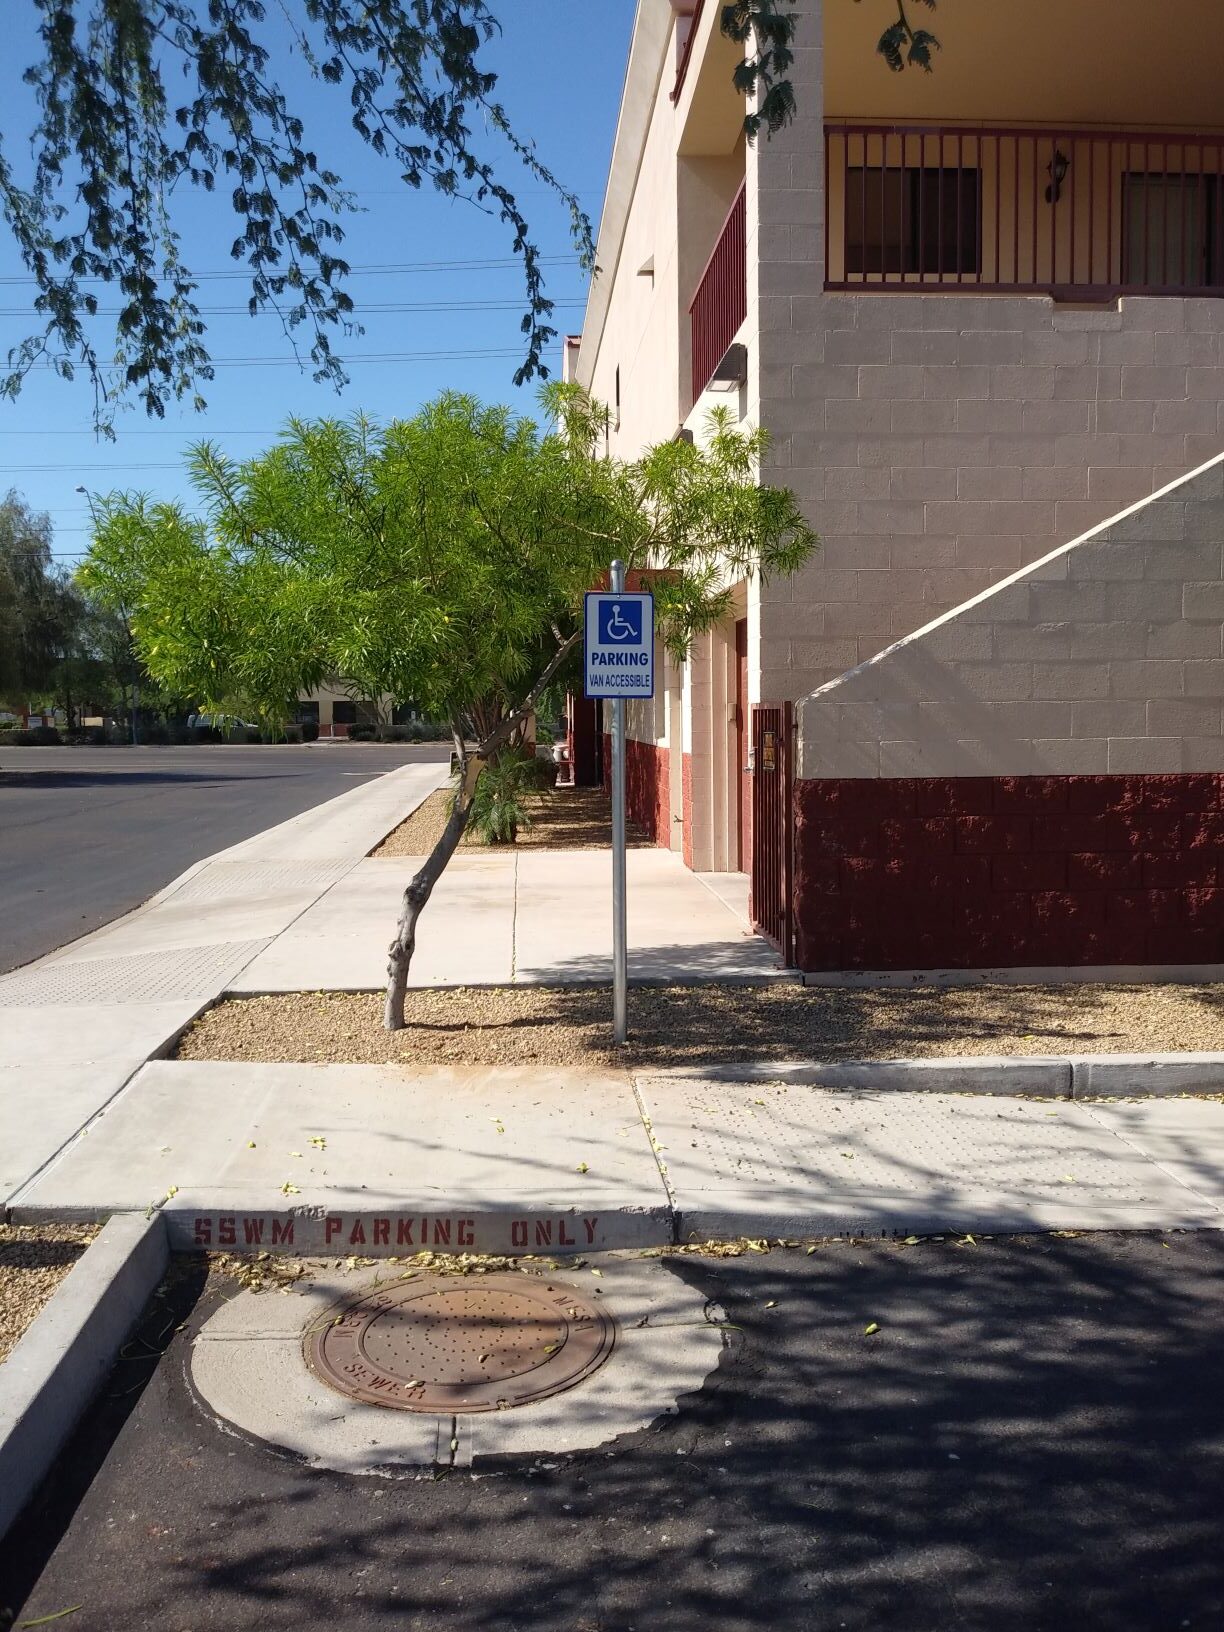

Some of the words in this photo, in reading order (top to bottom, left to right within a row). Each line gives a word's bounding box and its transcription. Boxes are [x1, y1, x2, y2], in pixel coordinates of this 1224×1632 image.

[591, 652, 649, 666] PARKING
[589, 674, 604, 687] VAN
[605, 674, 650, 688] ACCESSIBLE
[193, 1217, 295, 1246] SSWM
[325, 1216, 475, 1247] PARKING
[511, 1217, 600, 1247] ONLY
[343, 1363, 427, 1400] SEWER
